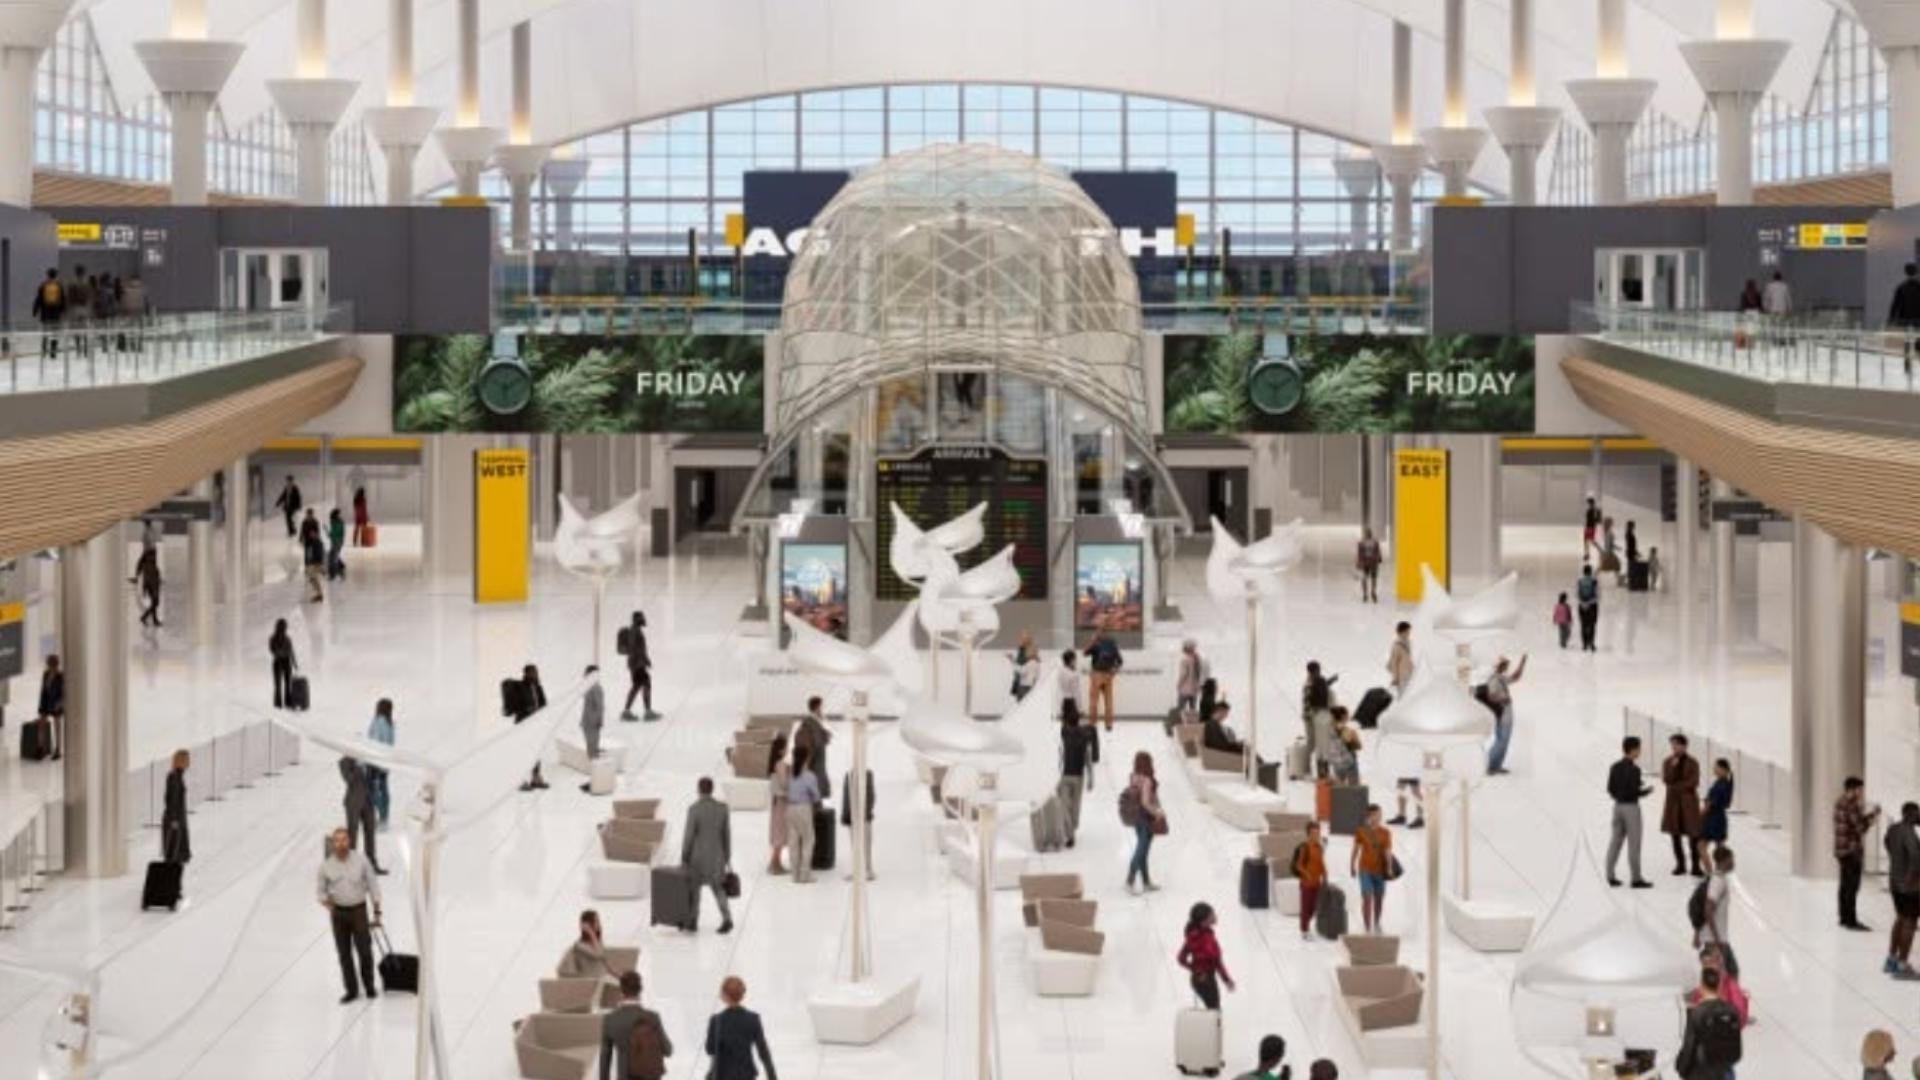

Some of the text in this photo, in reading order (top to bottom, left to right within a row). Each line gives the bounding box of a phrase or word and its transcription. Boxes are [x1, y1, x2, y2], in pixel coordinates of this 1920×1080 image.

[637, 371, 746, 395] FRIDAY
[1407, 371, 1516, 395] FRIDAY
[481, 464, 526, 476] WEST
[1401, 464, 1441, 476] EAST
